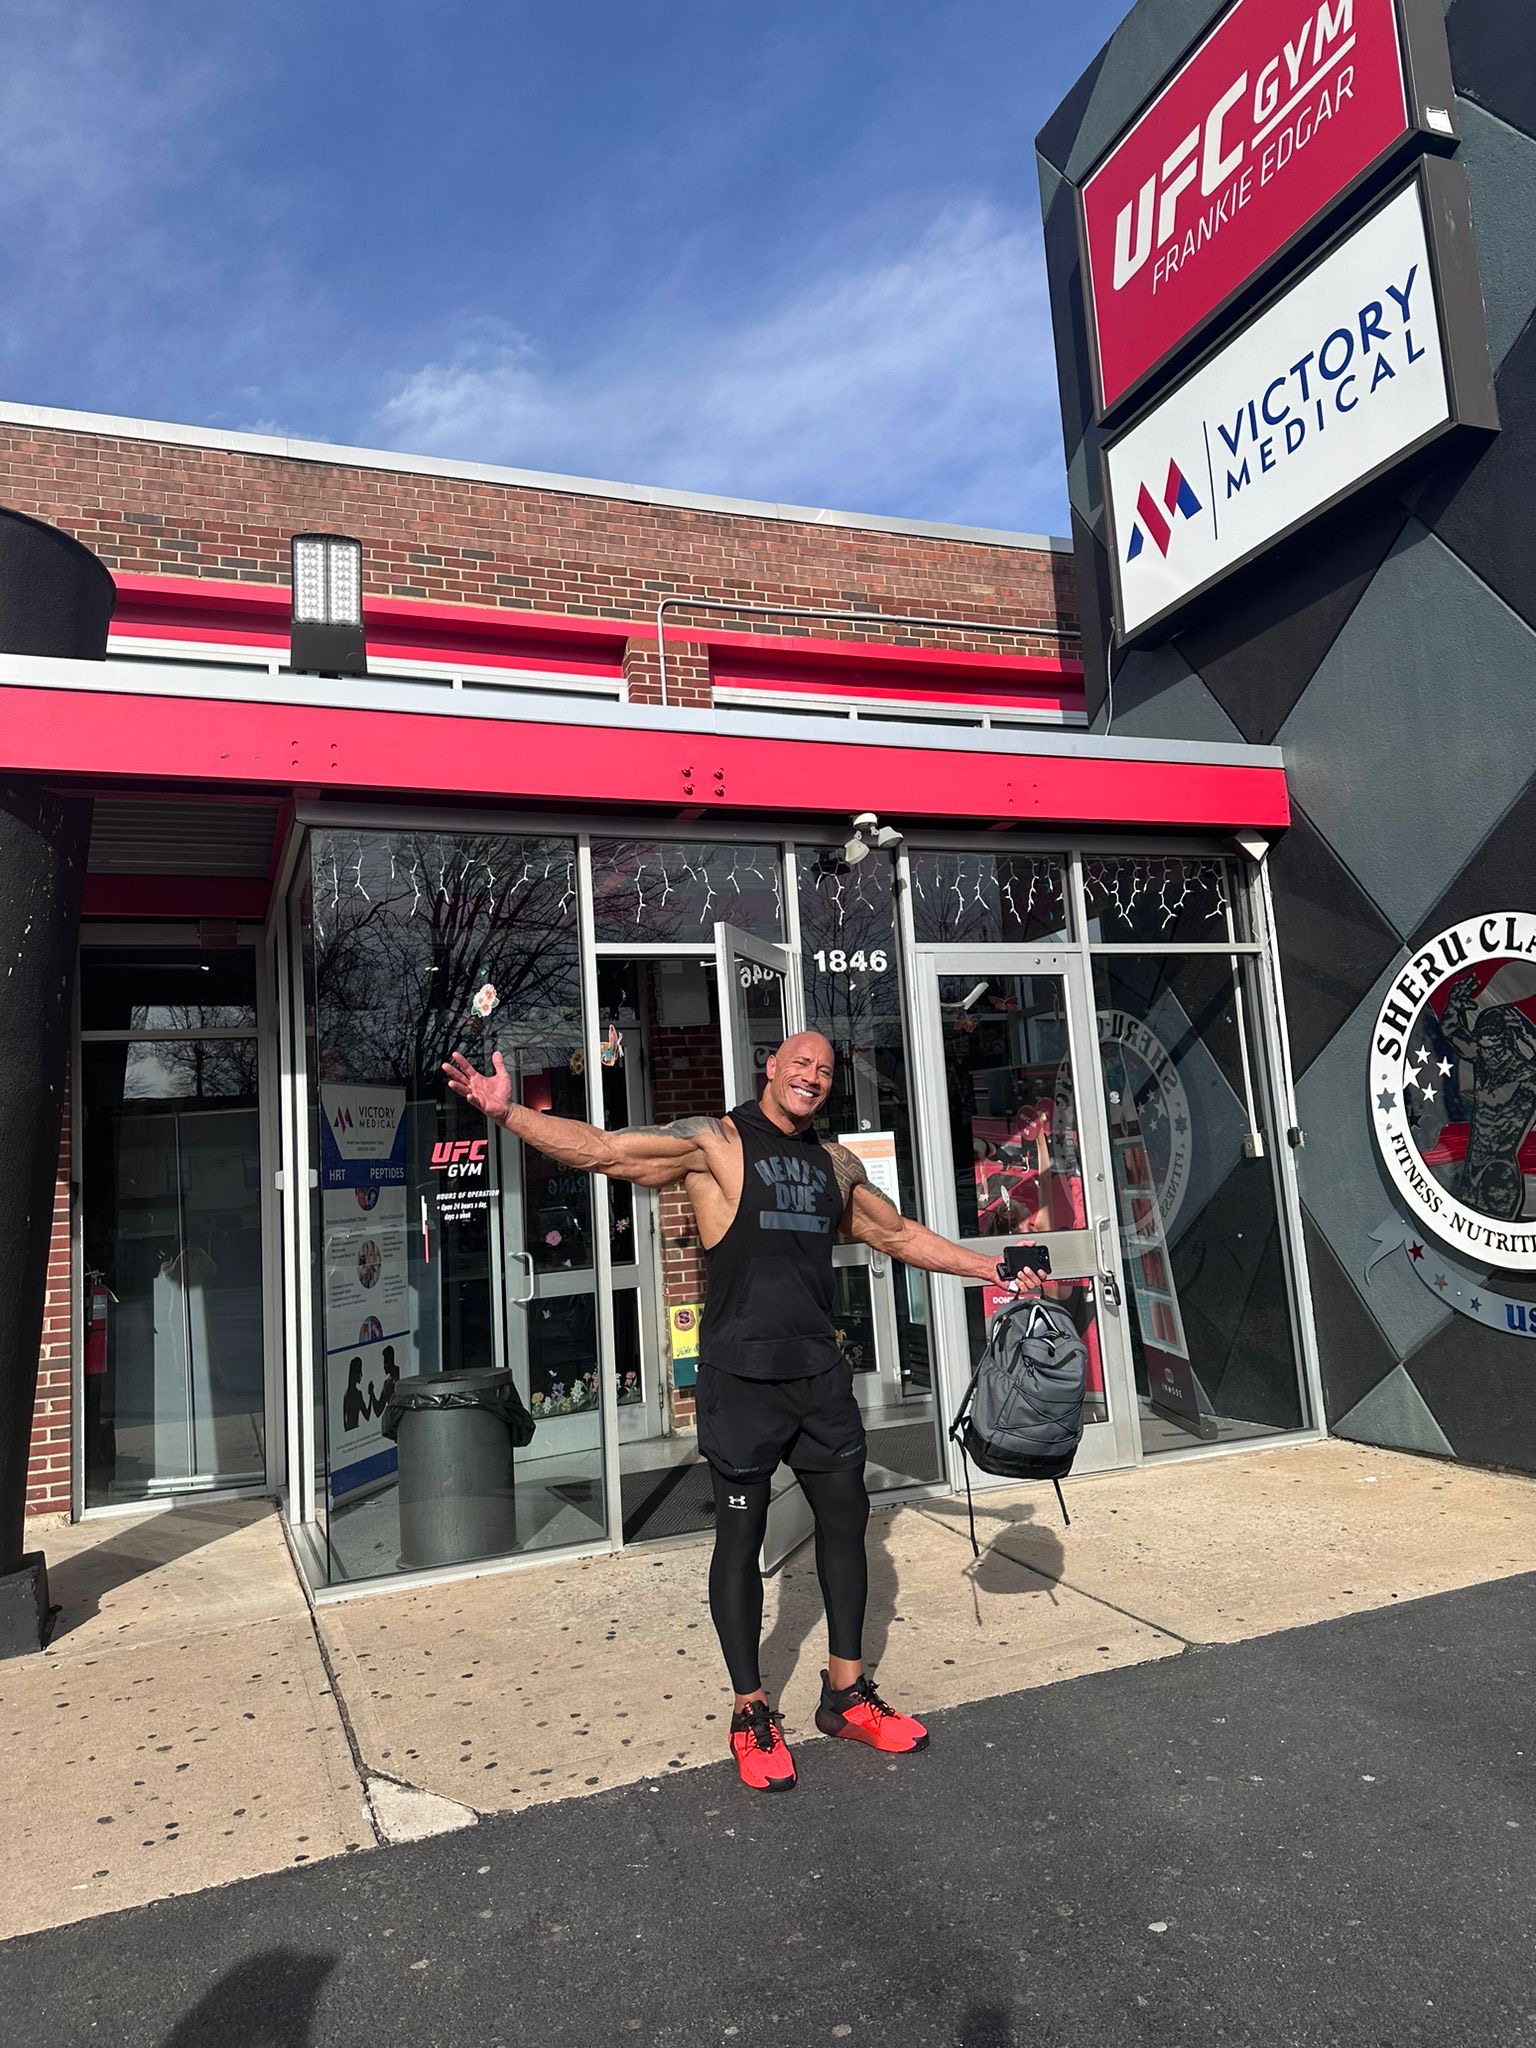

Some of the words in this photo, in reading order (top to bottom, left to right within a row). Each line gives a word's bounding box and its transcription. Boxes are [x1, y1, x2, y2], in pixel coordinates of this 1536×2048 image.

[1113, 70, 1248, 291] UFC
[1252, 0, 1354, 126] GYM
[1152, 174, 1253, 295] FRANKIE
[1260, 65, 1355, 185] EDGAR
[1217, 264, 1419, 457] VICTORY
[1226, 328, 1426, 500] MEDICAL
[813, 949, 888, 973] 1846
[1377, 931, 1468, 1061] SHERU
[359, 1106, 395, 1119] VICTORY
[359, 1119, 395, 1129] MEDICAL
[431, 1139, 489, 1163] UFC
[329, 1168, 346, 1181] HRT
[370, 1167, 404, 1180] PEPTIDES
[447, 1162, 483, 1178] GYM
[1391, 1132, 1443, 1213] FITNESS
[436, 1192, 457, 1201] HOURS
[457, 1191, 466, 1199] OF
[467, 1189, 500, 1199] OPERATION
[441, 1203, 453, 1211] Open
[461, 1202, 474, 1210] hours
[775, 1182, 817, 1213] DUE
